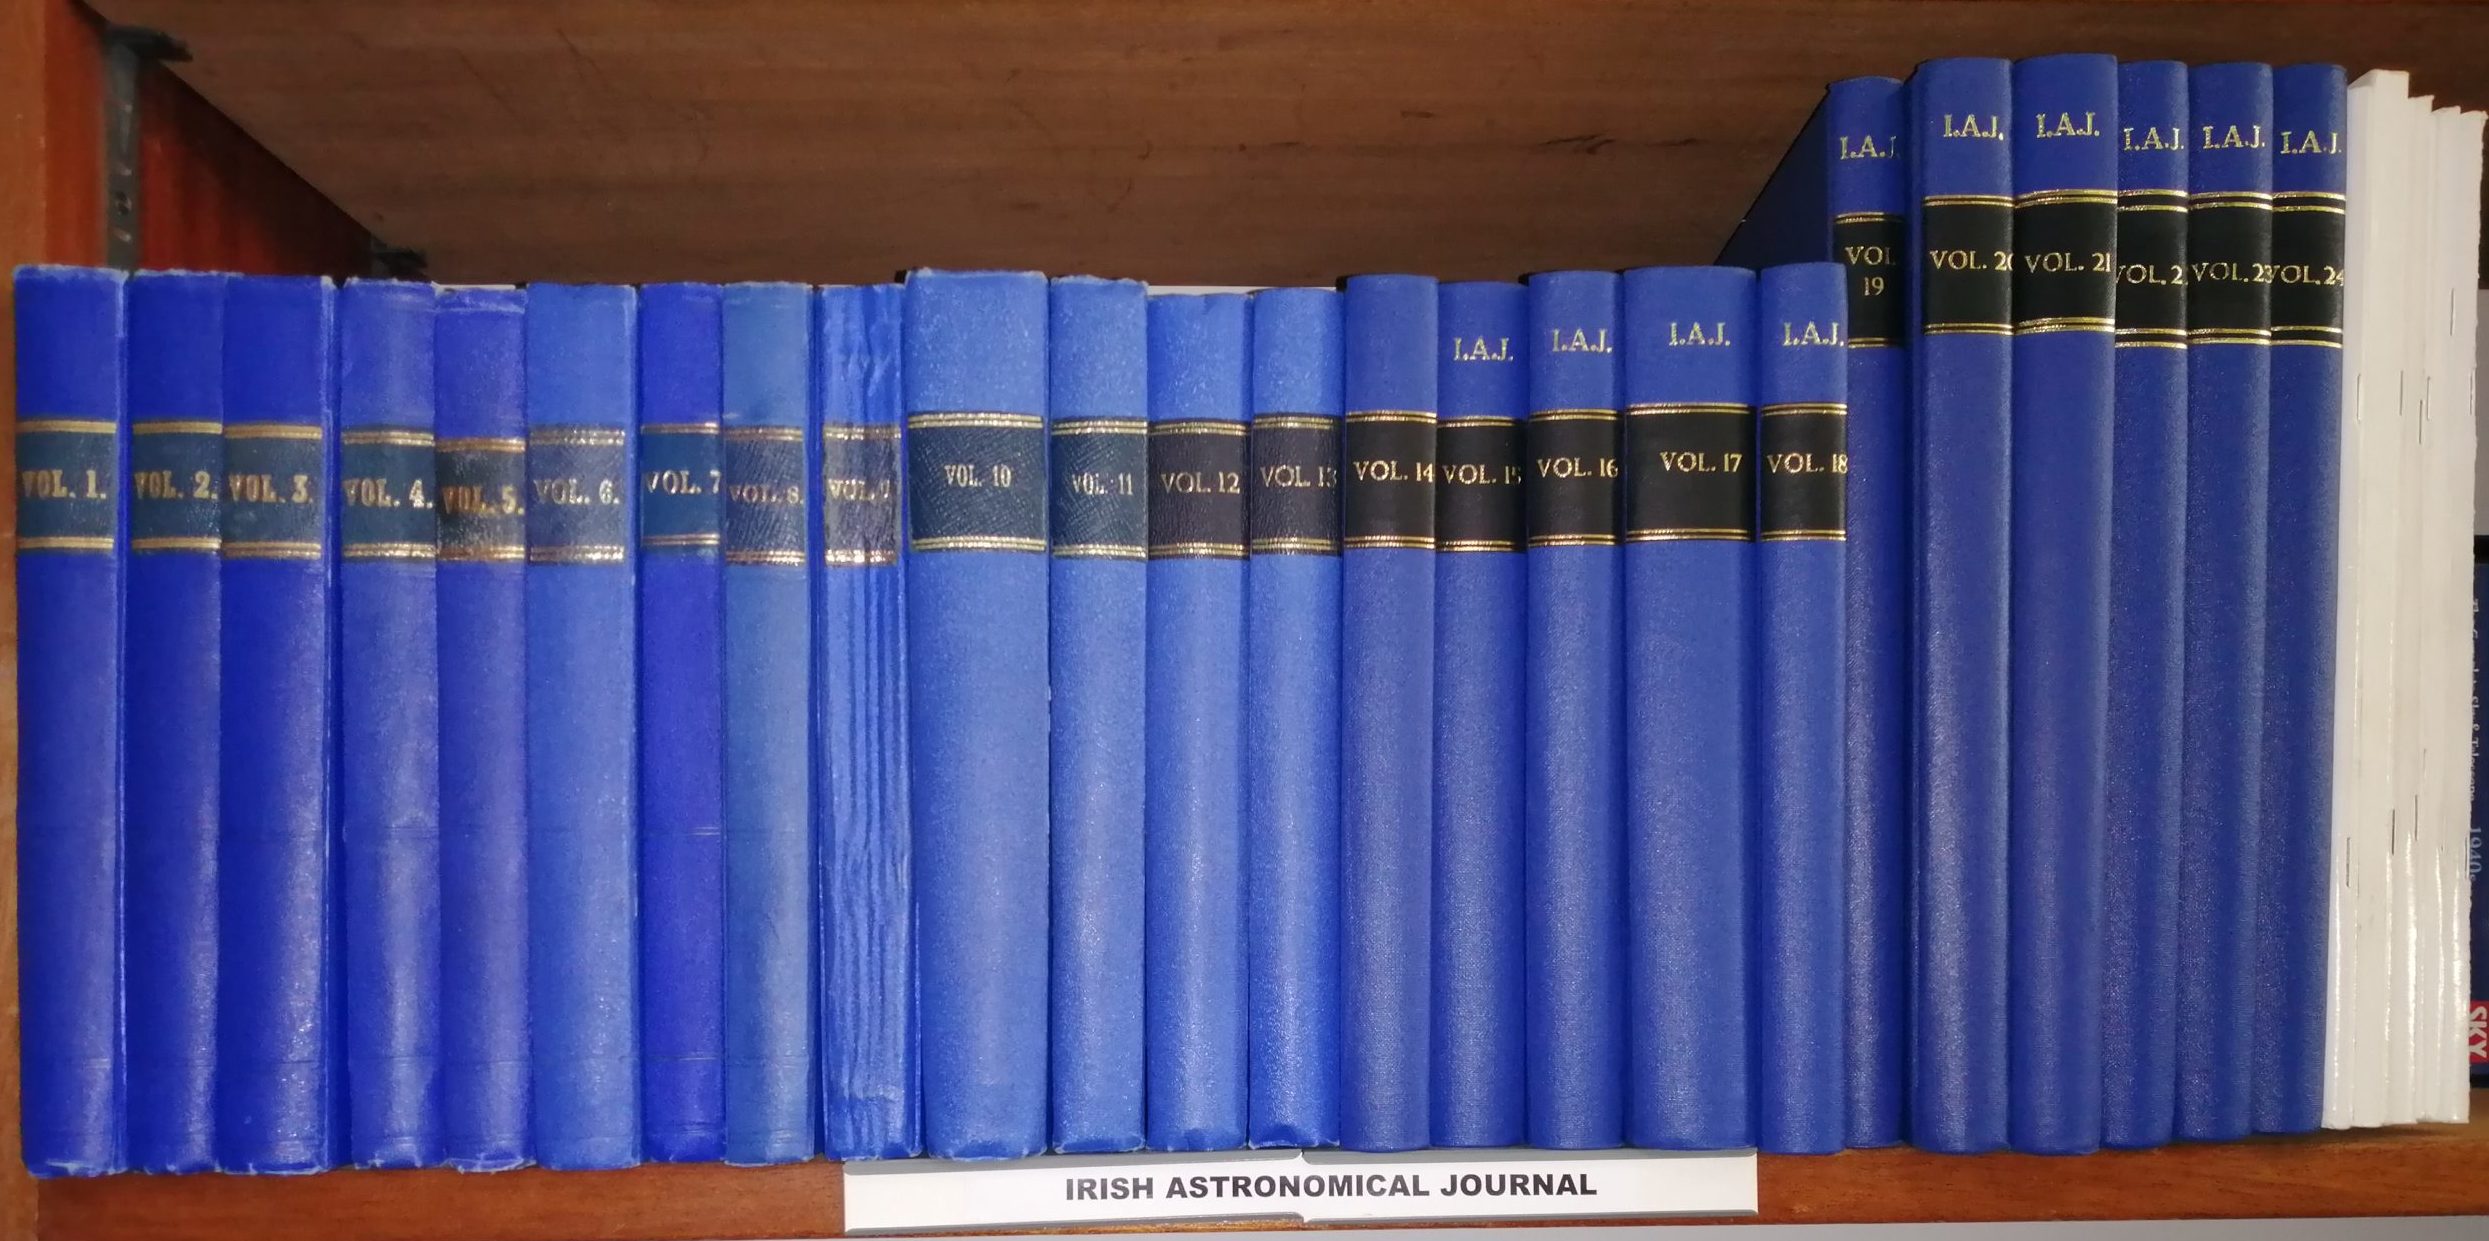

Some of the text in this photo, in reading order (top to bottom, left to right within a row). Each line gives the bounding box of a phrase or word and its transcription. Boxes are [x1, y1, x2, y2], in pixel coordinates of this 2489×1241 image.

[1943, 114, 2004, 141] I.A.J.
[2036, 111, 2100, 138] I.A.J.
[2124, 127, 2184, 151] I.A.J.
[2202, 125, 2265, 149] I.A.J.
[2280, 130, 2342, 154] I.A.J.
[1929, 250, 1987, 269] VOL.
[2024, 252, 2111, 273] VOL. 21
[2170, 264, 2188, 285] 2
[2191, 262, 2249, 283] VOL.
[1864, 276, 1885, 296] 19
[1553, 328, 1613, 353] I.A.J.
[1669, 321, 1731, 346] I.A.J.
[1783, 321, 1844, 346] I.A.J.
[1454, 336, 1514, 361] I.A.J.
[1353, 460, 1434, 482] VOL. 14
[1442, 464, 1497, 484] VOL.
[1537, 457, 1618, 478] VOL. 16
[1660, 452, 1742, 472] VOL. 17
[1767, 452, 1848, 474] VOL. 18
[22, 470, 77, 498] VOL.
[134, 471, 184, 498] VOL.
[646, 470, 721, 495] VOL. 7
[944, 464, 1012, 487] VOL. 10
[1072, 472, 1134, 496] VOL. 11
[1218, 471, 1240, 494] 12
[1318, 466, 1337, 488] 13
[229, 474, 286, 503] VOL.
[344, 478, 400, 506] VOL.
[533, 478, 590, 504] VOL.
[2469, 1005, 2488, 1058] SKY
[1066, 1173, 1597, 1200] IRISH ASTRONOMICAL JOURNAL
